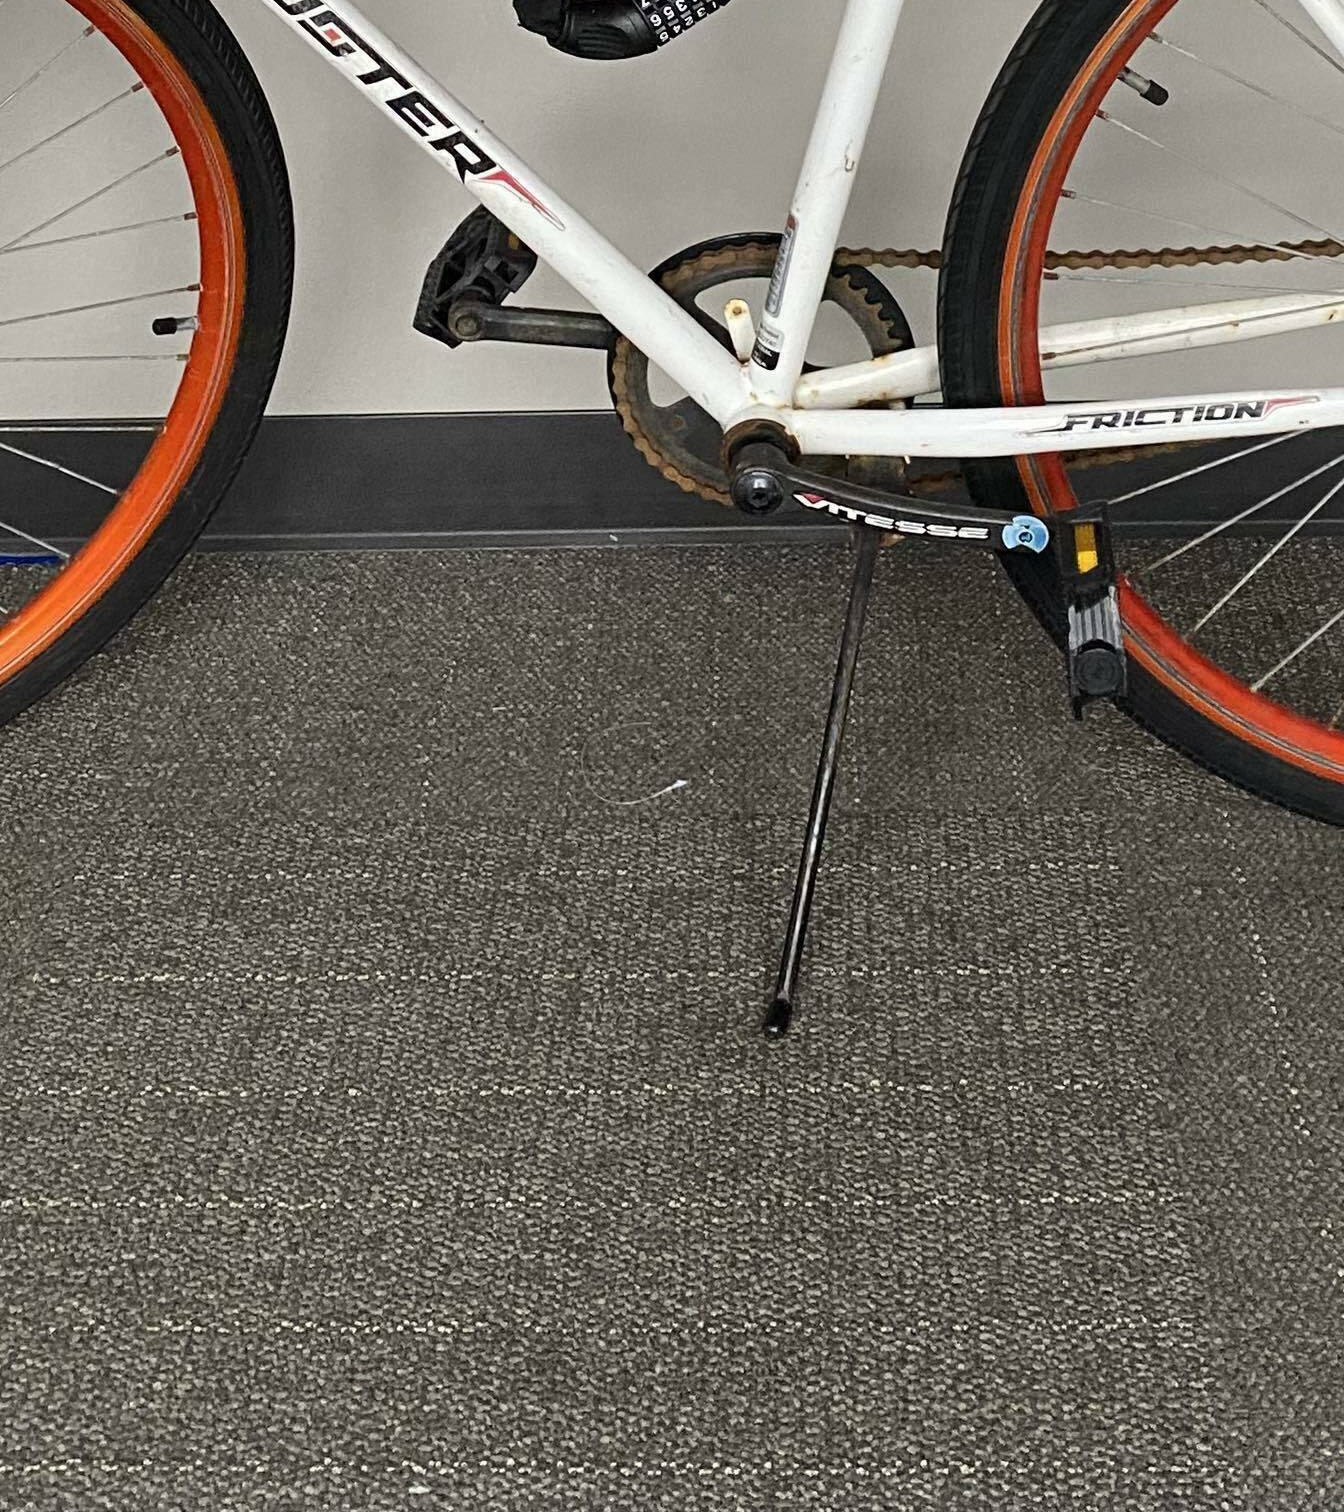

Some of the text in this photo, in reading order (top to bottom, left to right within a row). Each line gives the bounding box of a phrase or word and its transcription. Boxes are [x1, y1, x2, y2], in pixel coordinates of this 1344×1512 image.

[650, 14, 662, 27] 6
[663, 6, 675, 20] 5
[1059, 399, 1266, 432] FRICTION
[793, 492, 989, 540] VITESSE
